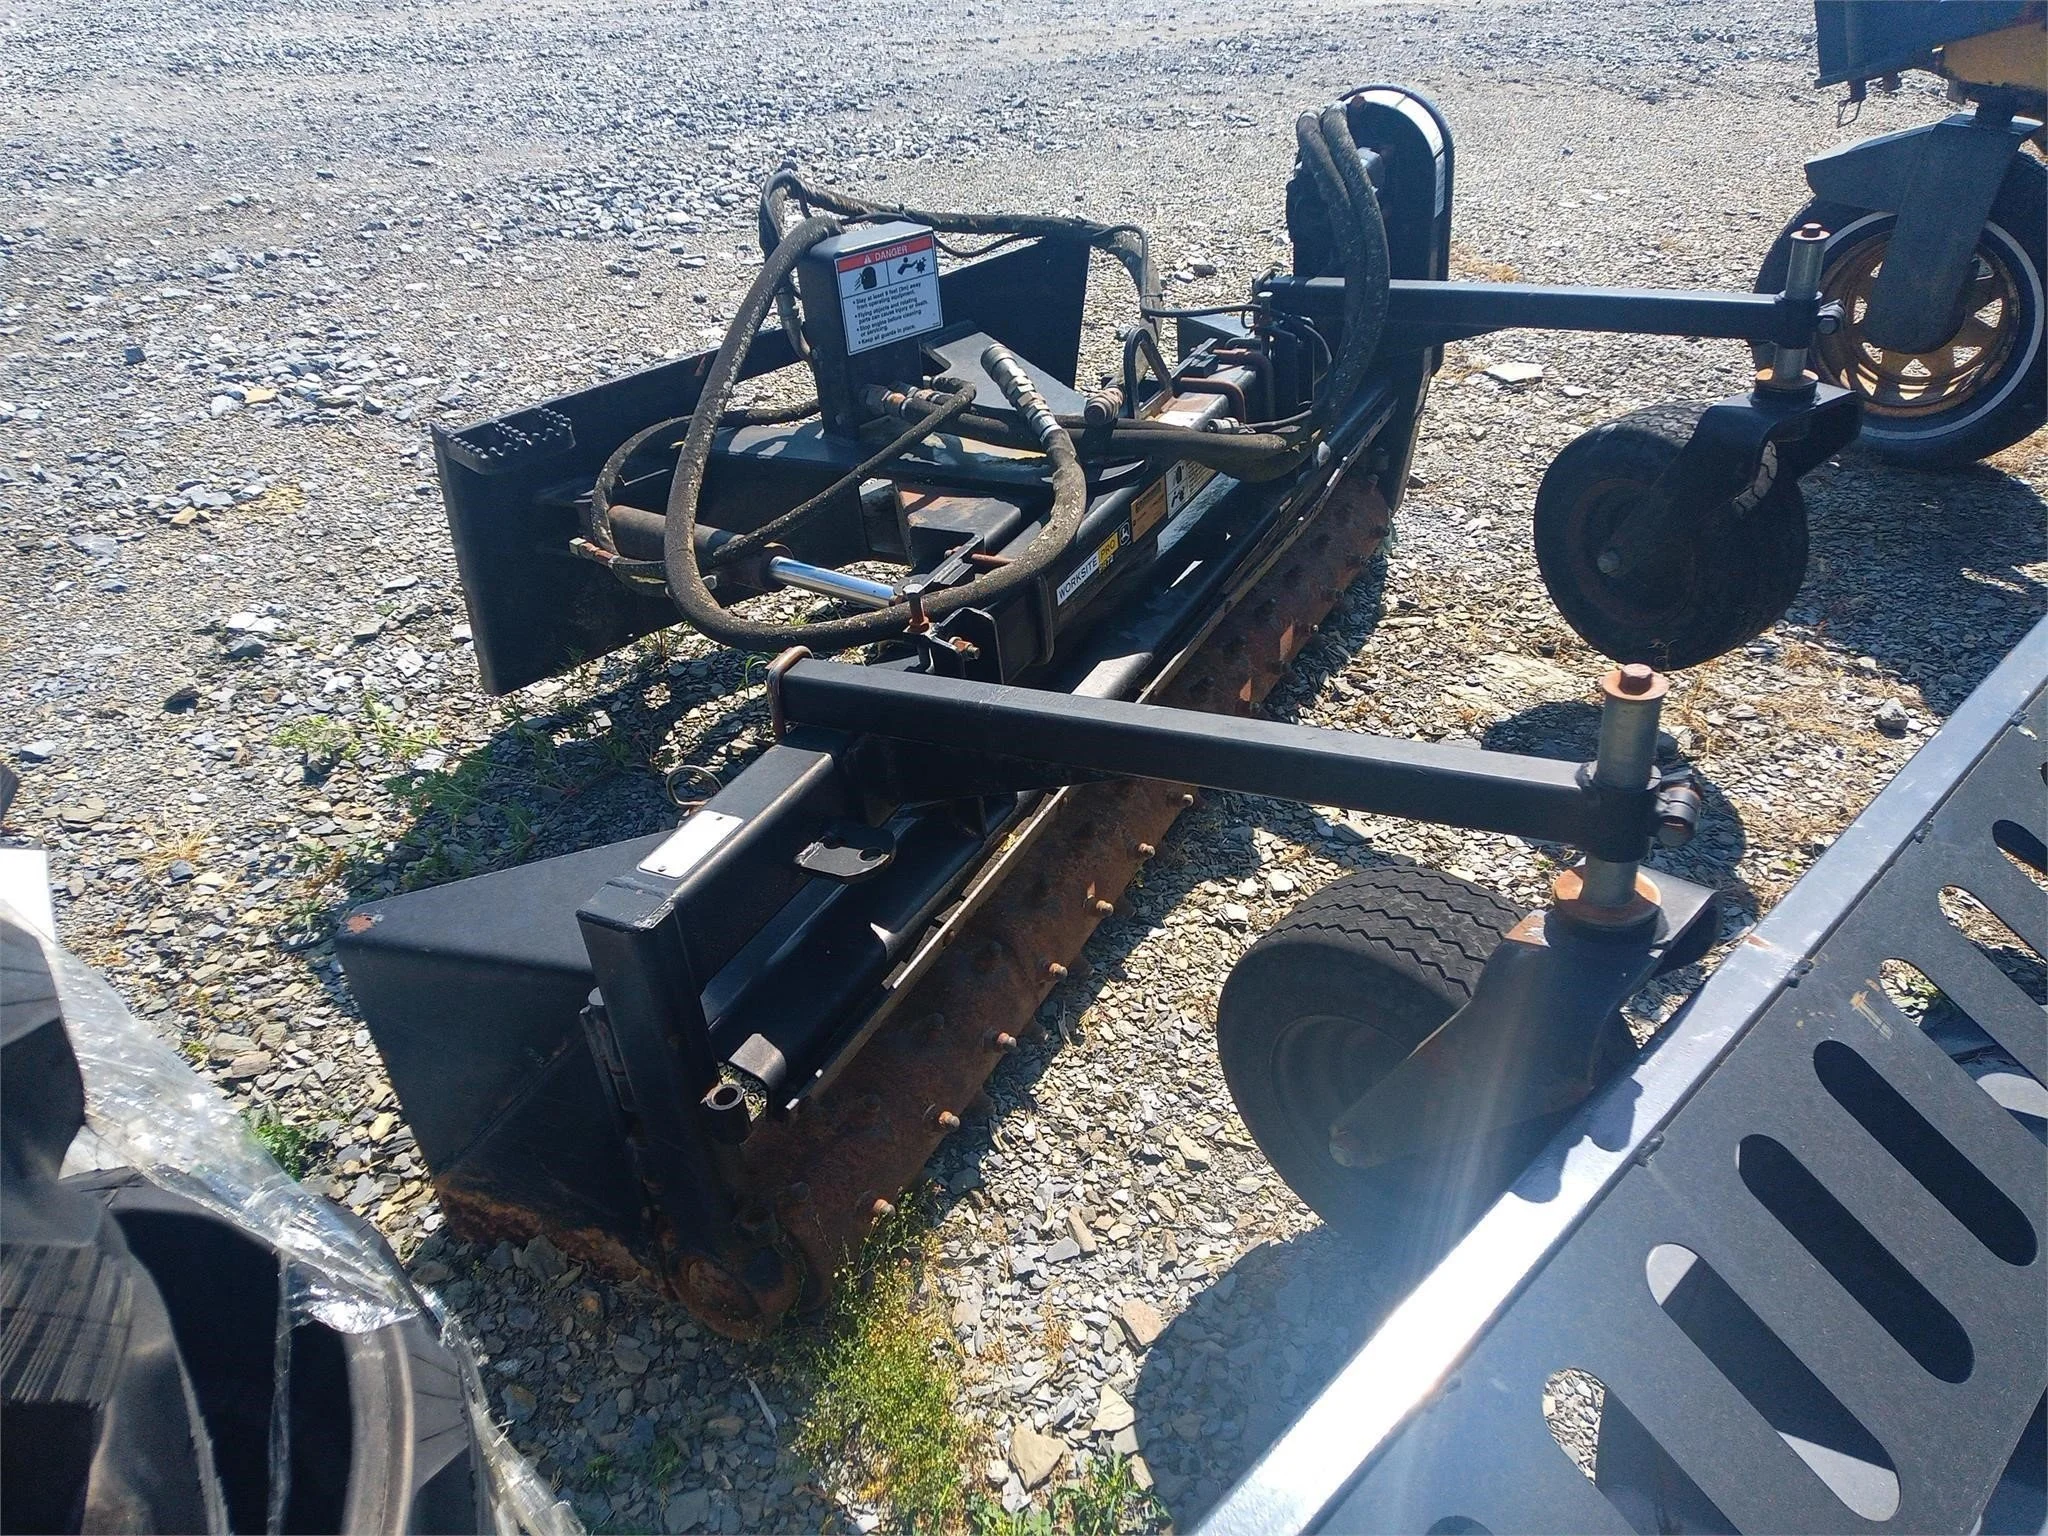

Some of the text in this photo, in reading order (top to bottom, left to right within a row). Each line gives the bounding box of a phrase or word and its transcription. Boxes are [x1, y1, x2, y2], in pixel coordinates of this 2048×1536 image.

[875, 246, 908, 261] DANGER
[910, 282, 921, 290] away
[858, 310, 872, 319] Flying
[873, 305, 889, 314] objects
[900, 297, 917, 307] rotating
[869, 297, 890, 308] operating
[859, 317, 871, 325] parts
[895, 306, 908, 314] injury
[872, 320, 887, 328] engine
[888, 315, 901, 323] before
[903, 309, 921, 319] cleaning
[862, 337, 873, 345] Keep
[881, 330, 896, 339] guards
[1058, 555, 1098, 600] WORKSITE
[1100, 539, 1116, 560] PRO
